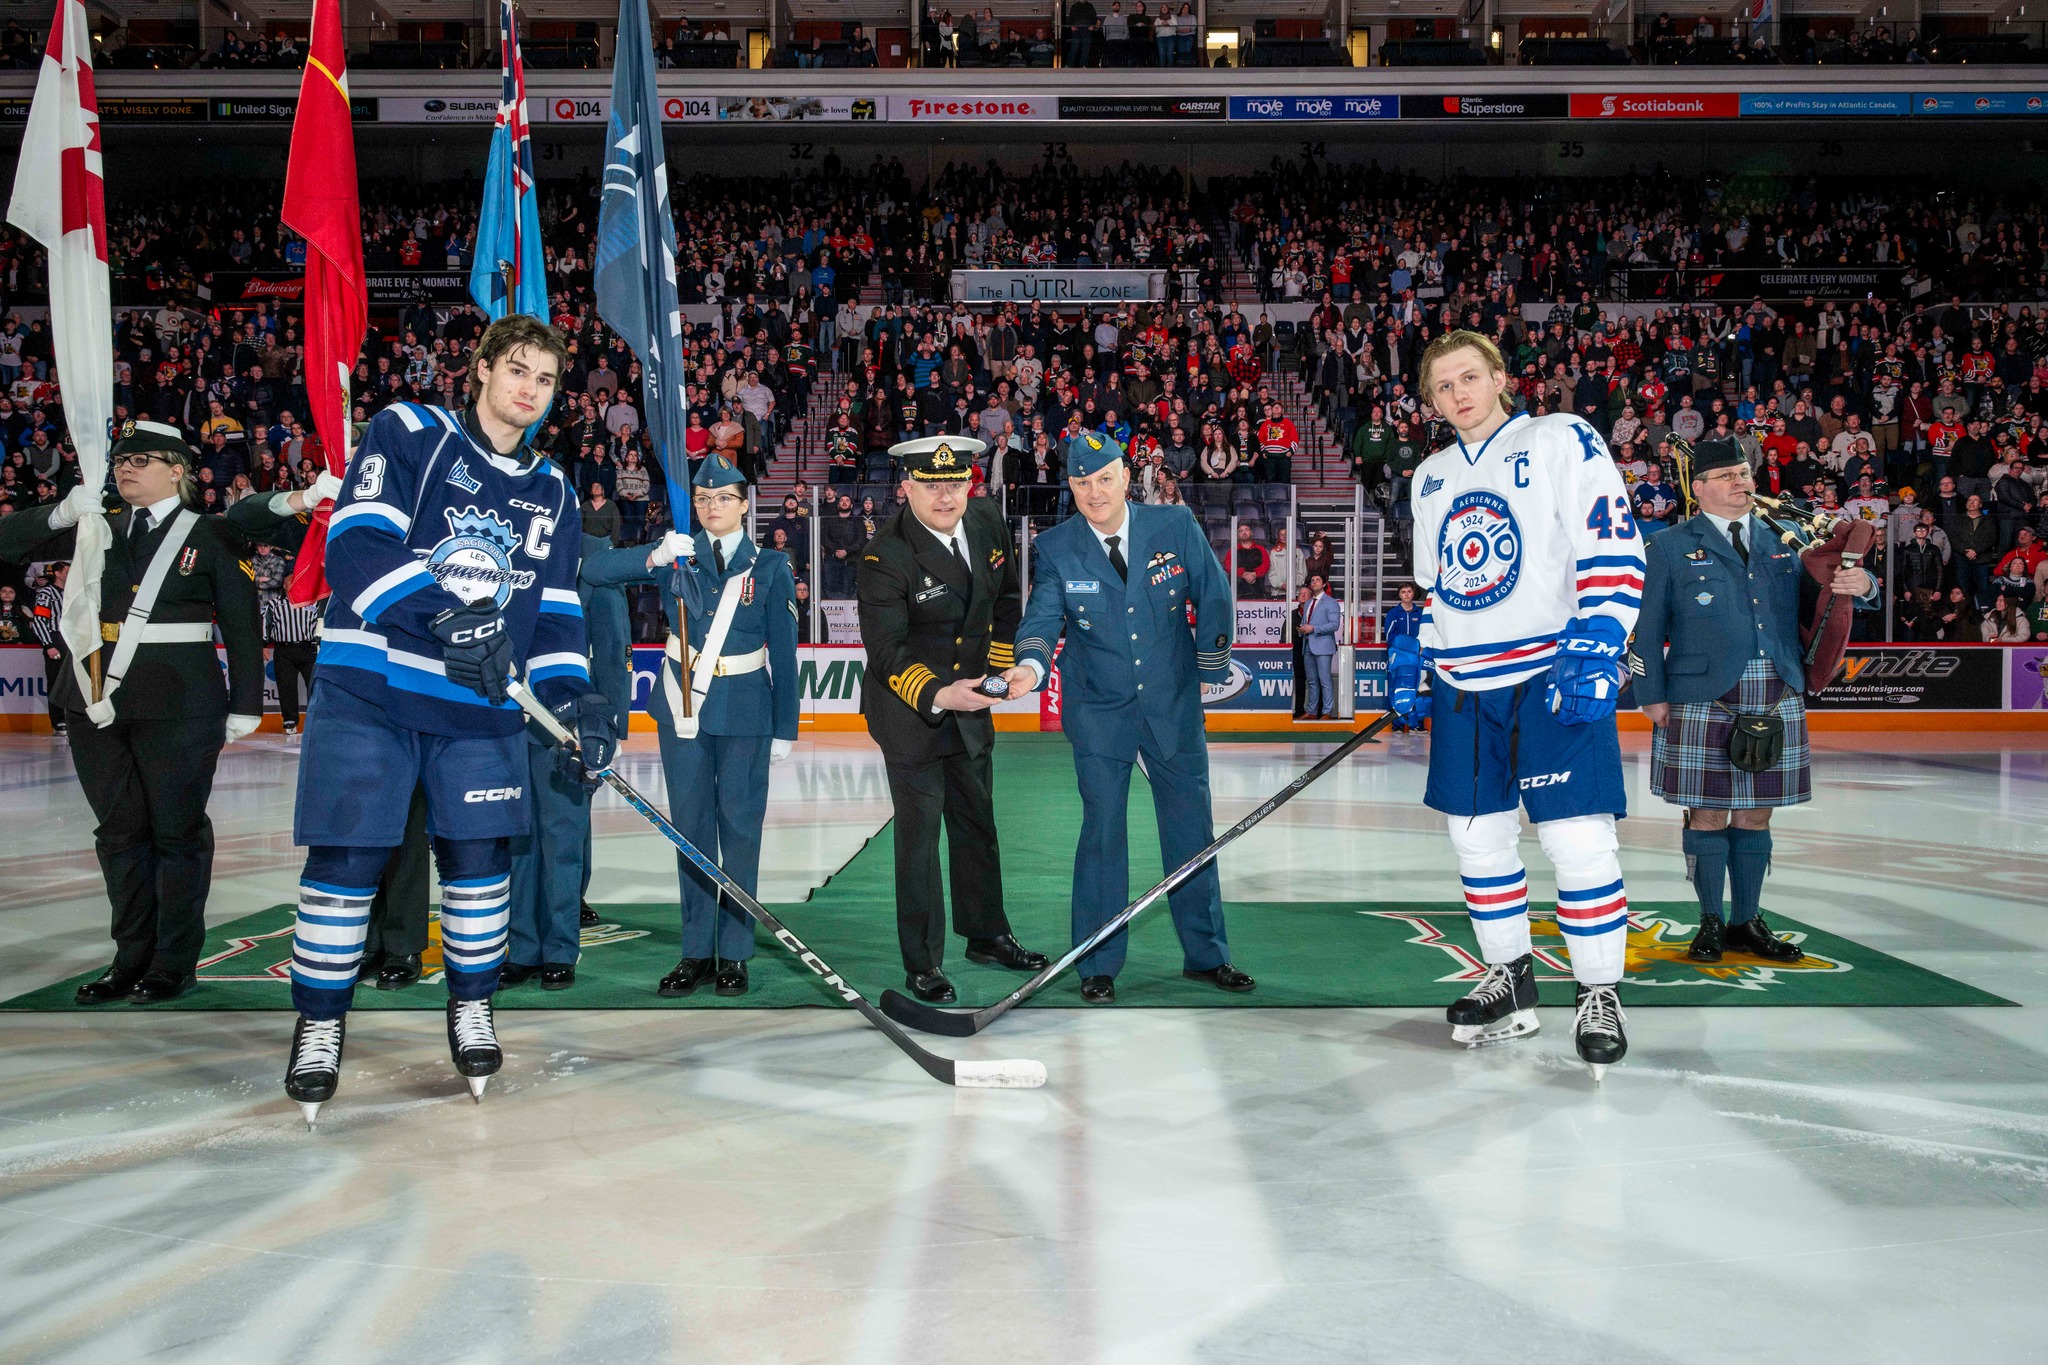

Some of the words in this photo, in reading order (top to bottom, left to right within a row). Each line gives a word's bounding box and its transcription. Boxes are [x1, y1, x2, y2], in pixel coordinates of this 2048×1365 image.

[4, 107, 29, 115] ONE.
[98, 106, 119, 115] AT'S
[121, 106, 159, 114] WISELY
[162, 106, 195, 115] DONE.
[233, 104, 266, 114] United
[555, 99, 602, 120] Q104
[664, 98, 711, 120] Q104
[830, 106, 849, 114] loves
[908, 99, 1031, 118] Firestone
[1179, 102, 1221, 110] CARSTAR
[1461, 103, 1524, 116] Superstore
[1622, 99, 1704, 112] Scotiabank
[1753, 101, 1773, 109] 100%
[1785, 101, 1811, 109] Profits
[1812, 101, 1828, 110] Stay
[1838, 101, 1867, 109] Atlantic
[1869, 101, 1898, 109] Canada.
[788, 142, 814, 160] 32
[1042, 142, 1068, 159] 33
[1299, 142, 1327, 159] 34
[1558, 140, 1585, 158] 35
[244, 281, 303, 293] Budweiser
[366, 277, 393, 288] BRATE
[422, 277, 463, 288] MOMENT.
[1760, 274, 1808, 284] CELEBRATE
[1810, 274, 1838, 284] EVERY
[1839, 274, 1880, 284] MOMENT.
[978, 286, 1003, 298] The
[1504, 450, 1529, 463] CCM
[353, 453, 387, 500] 3
[1514, 457, 1530, 489] C
[508, 498, 552, 517] CCM
[1459, 495, 1504, 511] AÉRIENNE
[1460, 514, 1484, 530] 1924
[1586, 495, 1637, 540] 43
[524, 515, 554, 560] C
[456, 539, 504, 560] SAGUENAY
[469, 551, 486, 562] LES
[416, 552, 536, 589] aguenéens
[1448, 594, 1472, 607] YOUR
[1474, 596, 1492, 607] AIR
[1494, 568, 1518, 598] FORCE
[1463, 573, 1488, 588] 2024
[461, 586, 471, 594] DE
[1237, 606, 1287, 619] eastlink
[1258, 661, 1284, 670] YOUR
[1837, 650, 1961, 683] ynite
[1519, 771, 1572, 790] CCM
[464, 786, 523, 803] CCM
[775, 928, 861, 1002] CCM
